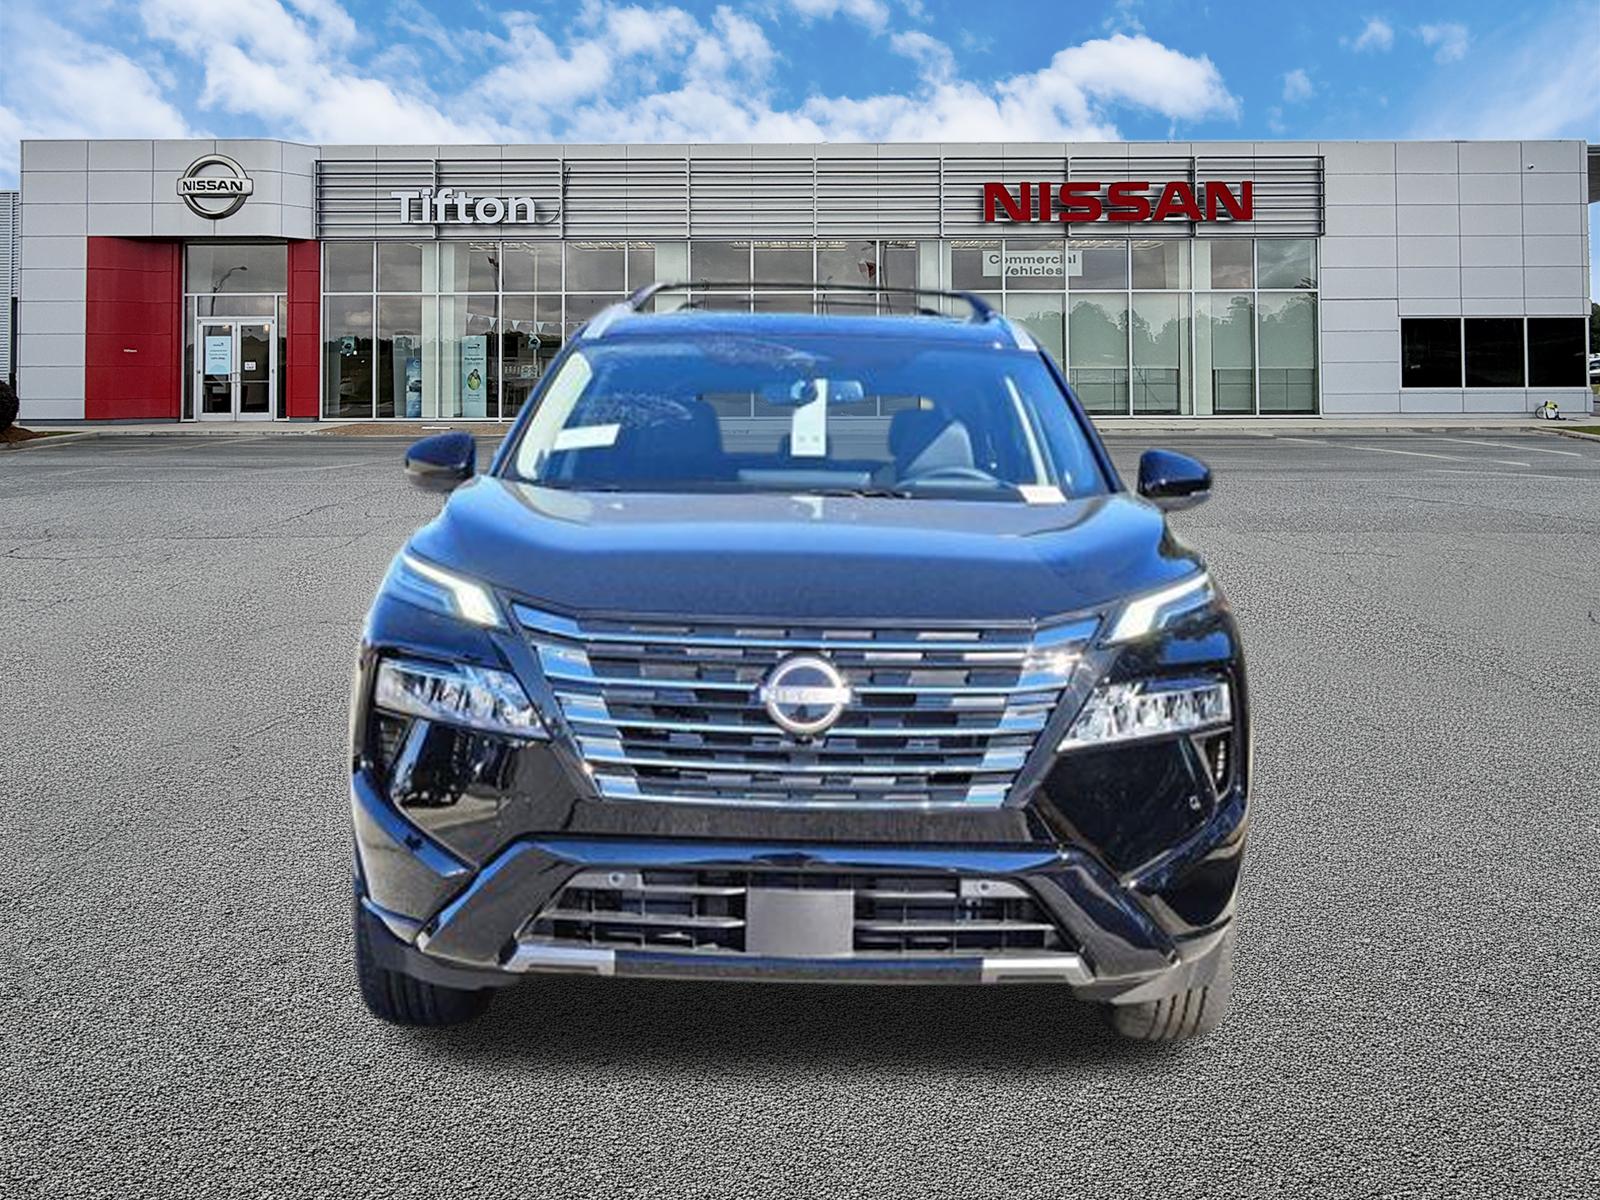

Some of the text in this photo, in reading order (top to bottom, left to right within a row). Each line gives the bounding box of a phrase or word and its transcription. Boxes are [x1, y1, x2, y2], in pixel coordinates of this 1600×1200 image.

[182, 181, 243, 191] NISSAN
[984, 181, 1254, 222] NISSAN
[391, 188, 536, 224] Tifton
